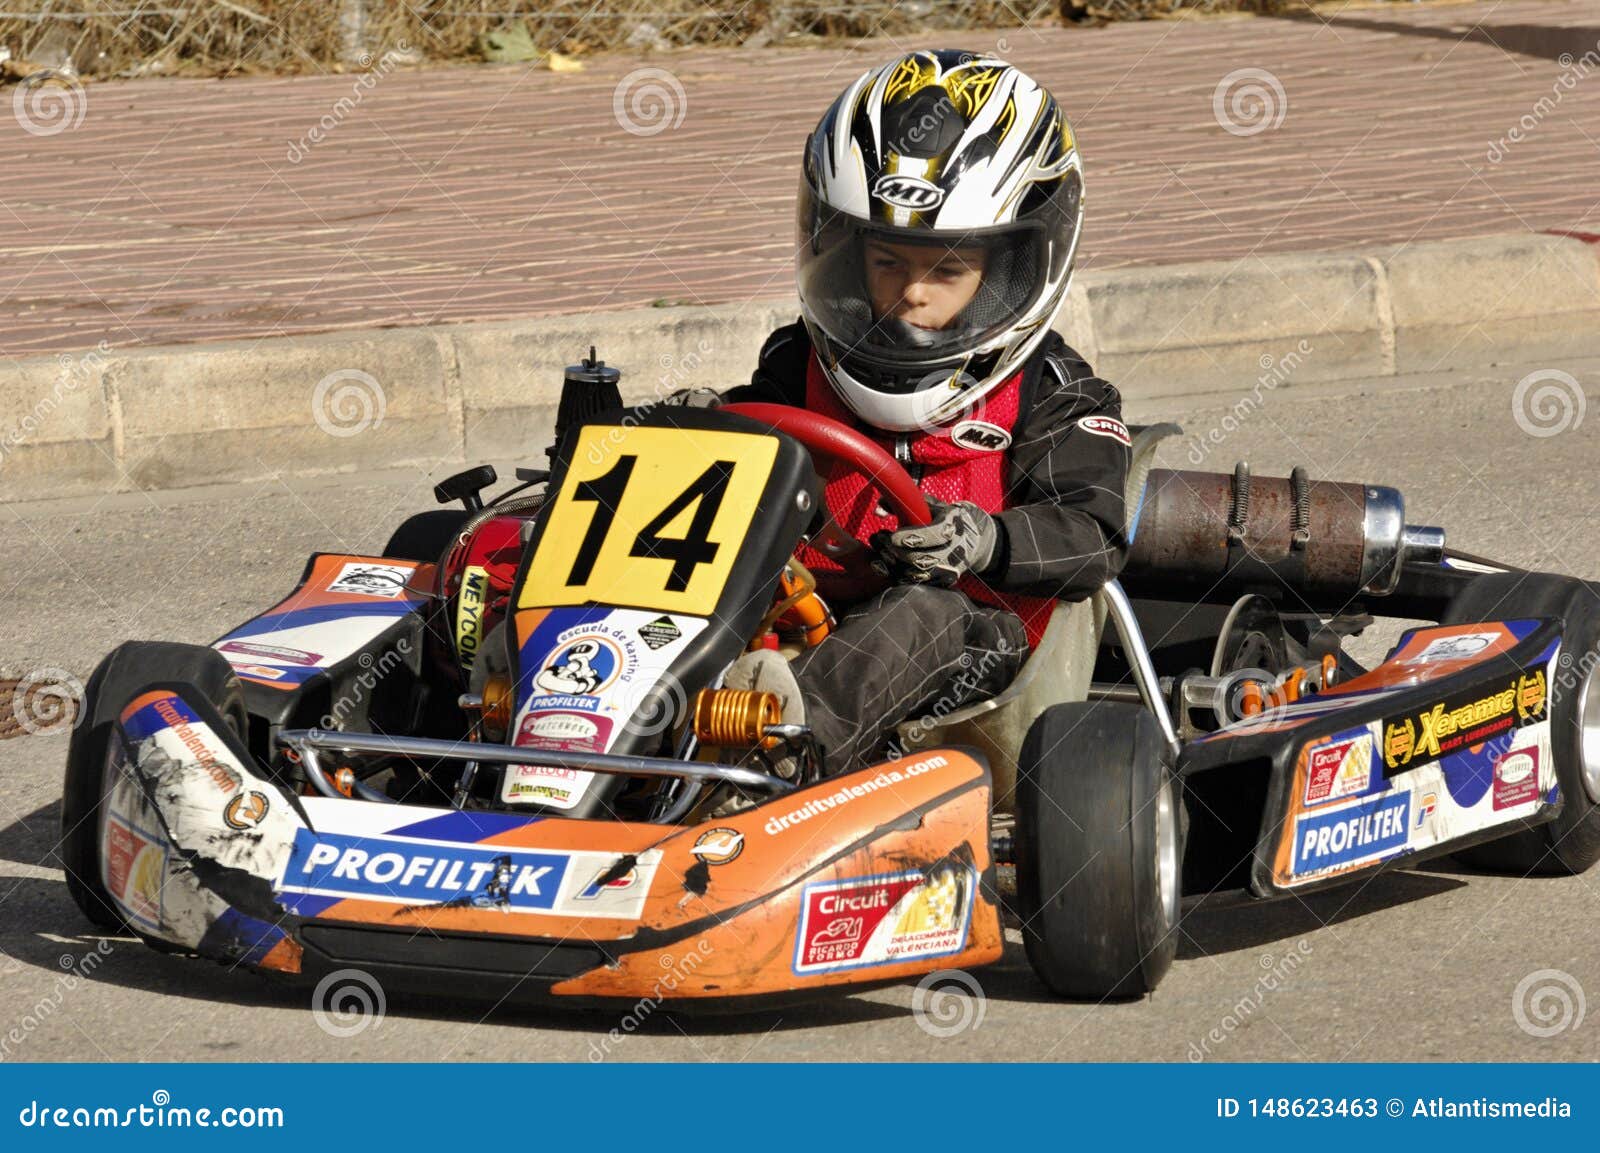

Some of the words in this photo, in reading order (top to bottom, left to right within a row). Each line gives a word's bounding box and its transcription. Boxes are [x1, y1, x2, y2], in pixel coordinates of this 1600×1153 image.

[564, 454, 738, 593] 14
[461, 571, 483, 670] MEYCOM
[560, 623, 609, 641] escuela
[612, 628, 627, 642] de
[620, 640, 641, 683] karting
[532, 697, 598, 709] PROFILTEK
[1413, 689, 1516, 757] Xeramic
[153, 697, 238, 794] circuitvalencia.com
[764, 754, 949, 836] circuitvalencia.com
[1302, 804, 1407, 861] PROFILTEK
[818, 889, 889, 915] Circuit
[808, 950, 856, 963] TORMO
[809, 942, 859, 956] RICARDO
[886, 939, 958, 956] VALENCIANA
